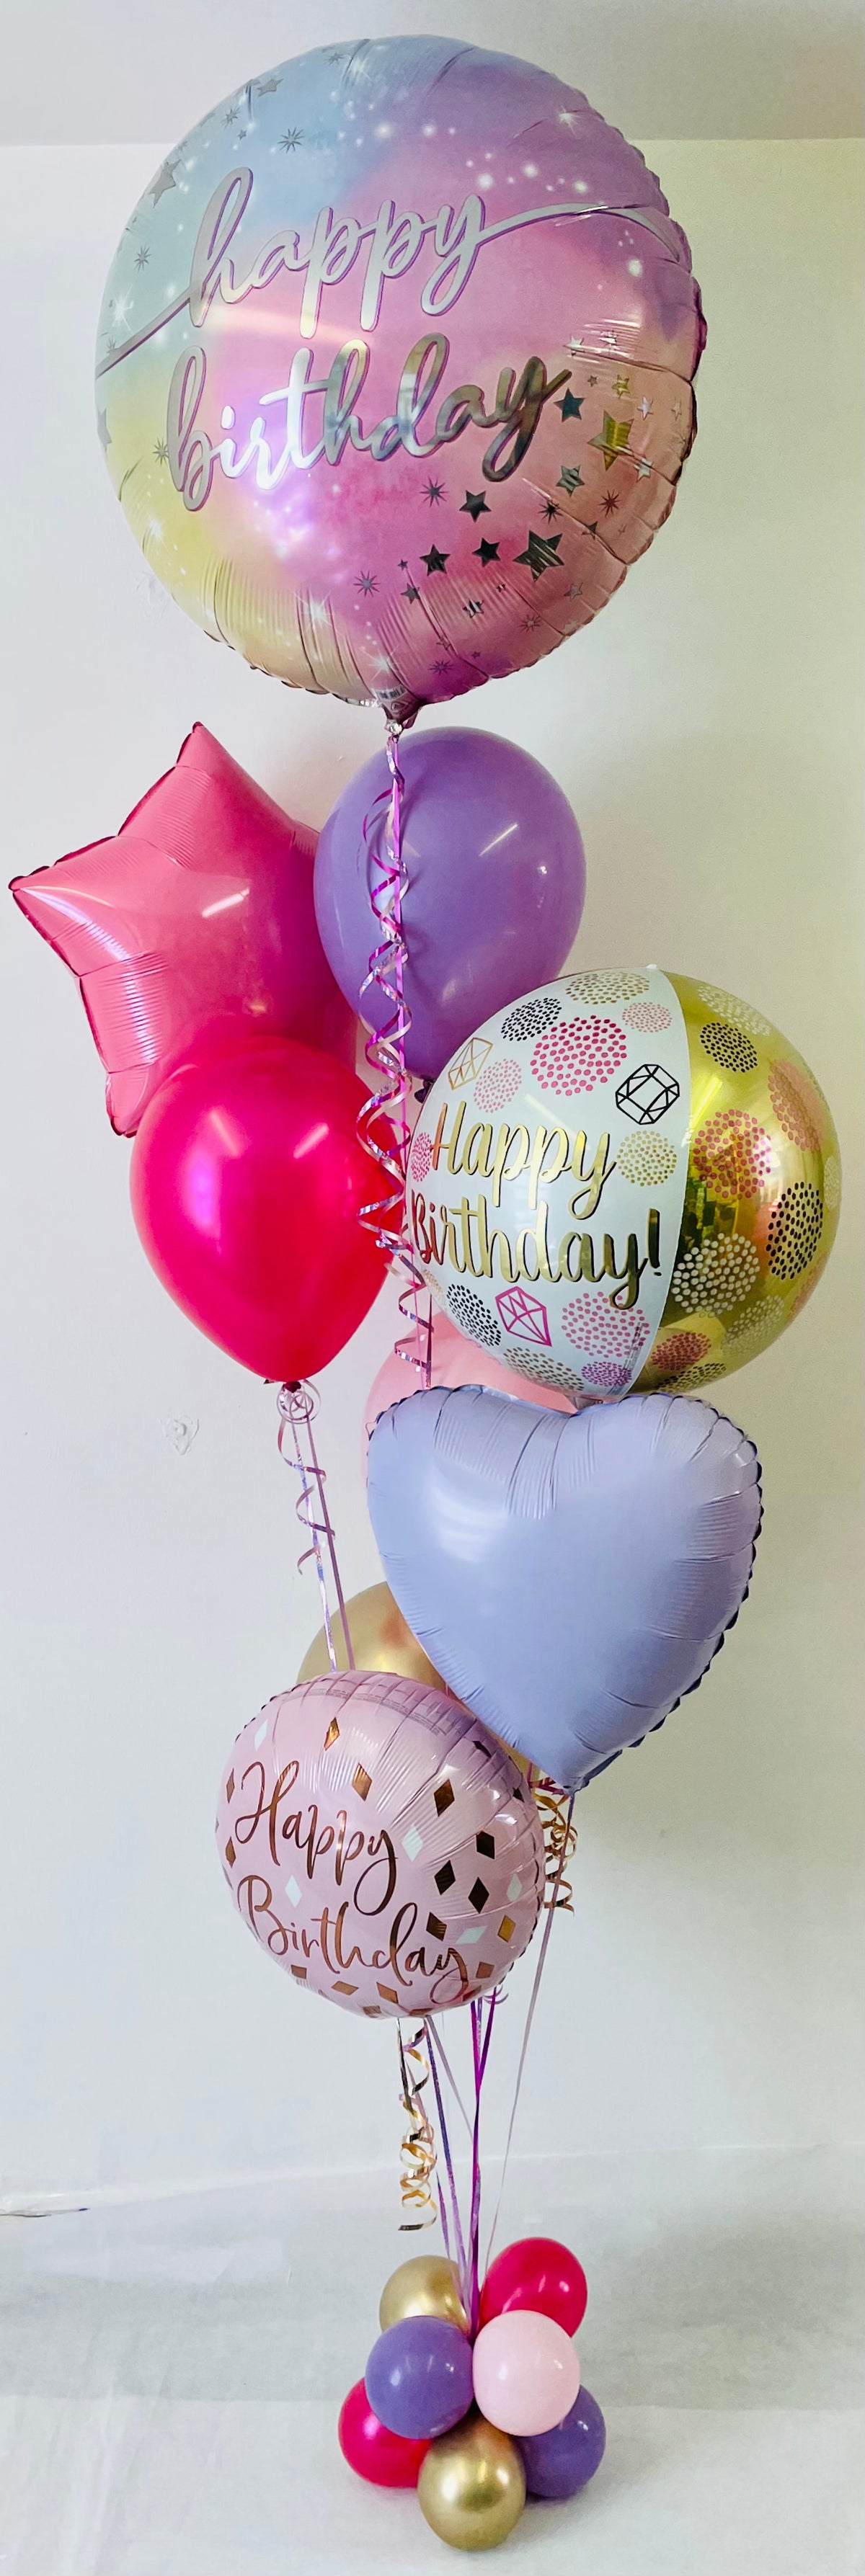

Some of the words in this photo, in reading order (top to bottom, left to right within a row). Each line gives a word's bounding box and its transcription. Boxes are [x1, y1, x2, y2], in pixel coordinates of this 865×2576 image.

[167, 331, 572, 512] birthday
[432, 1100, 616, 1220] Happy
[411, 1189, 661, 1310] Birthday!
[234, 1760, 398, 1916] Happy
[236, 1874, 469, 2005] Birthday
